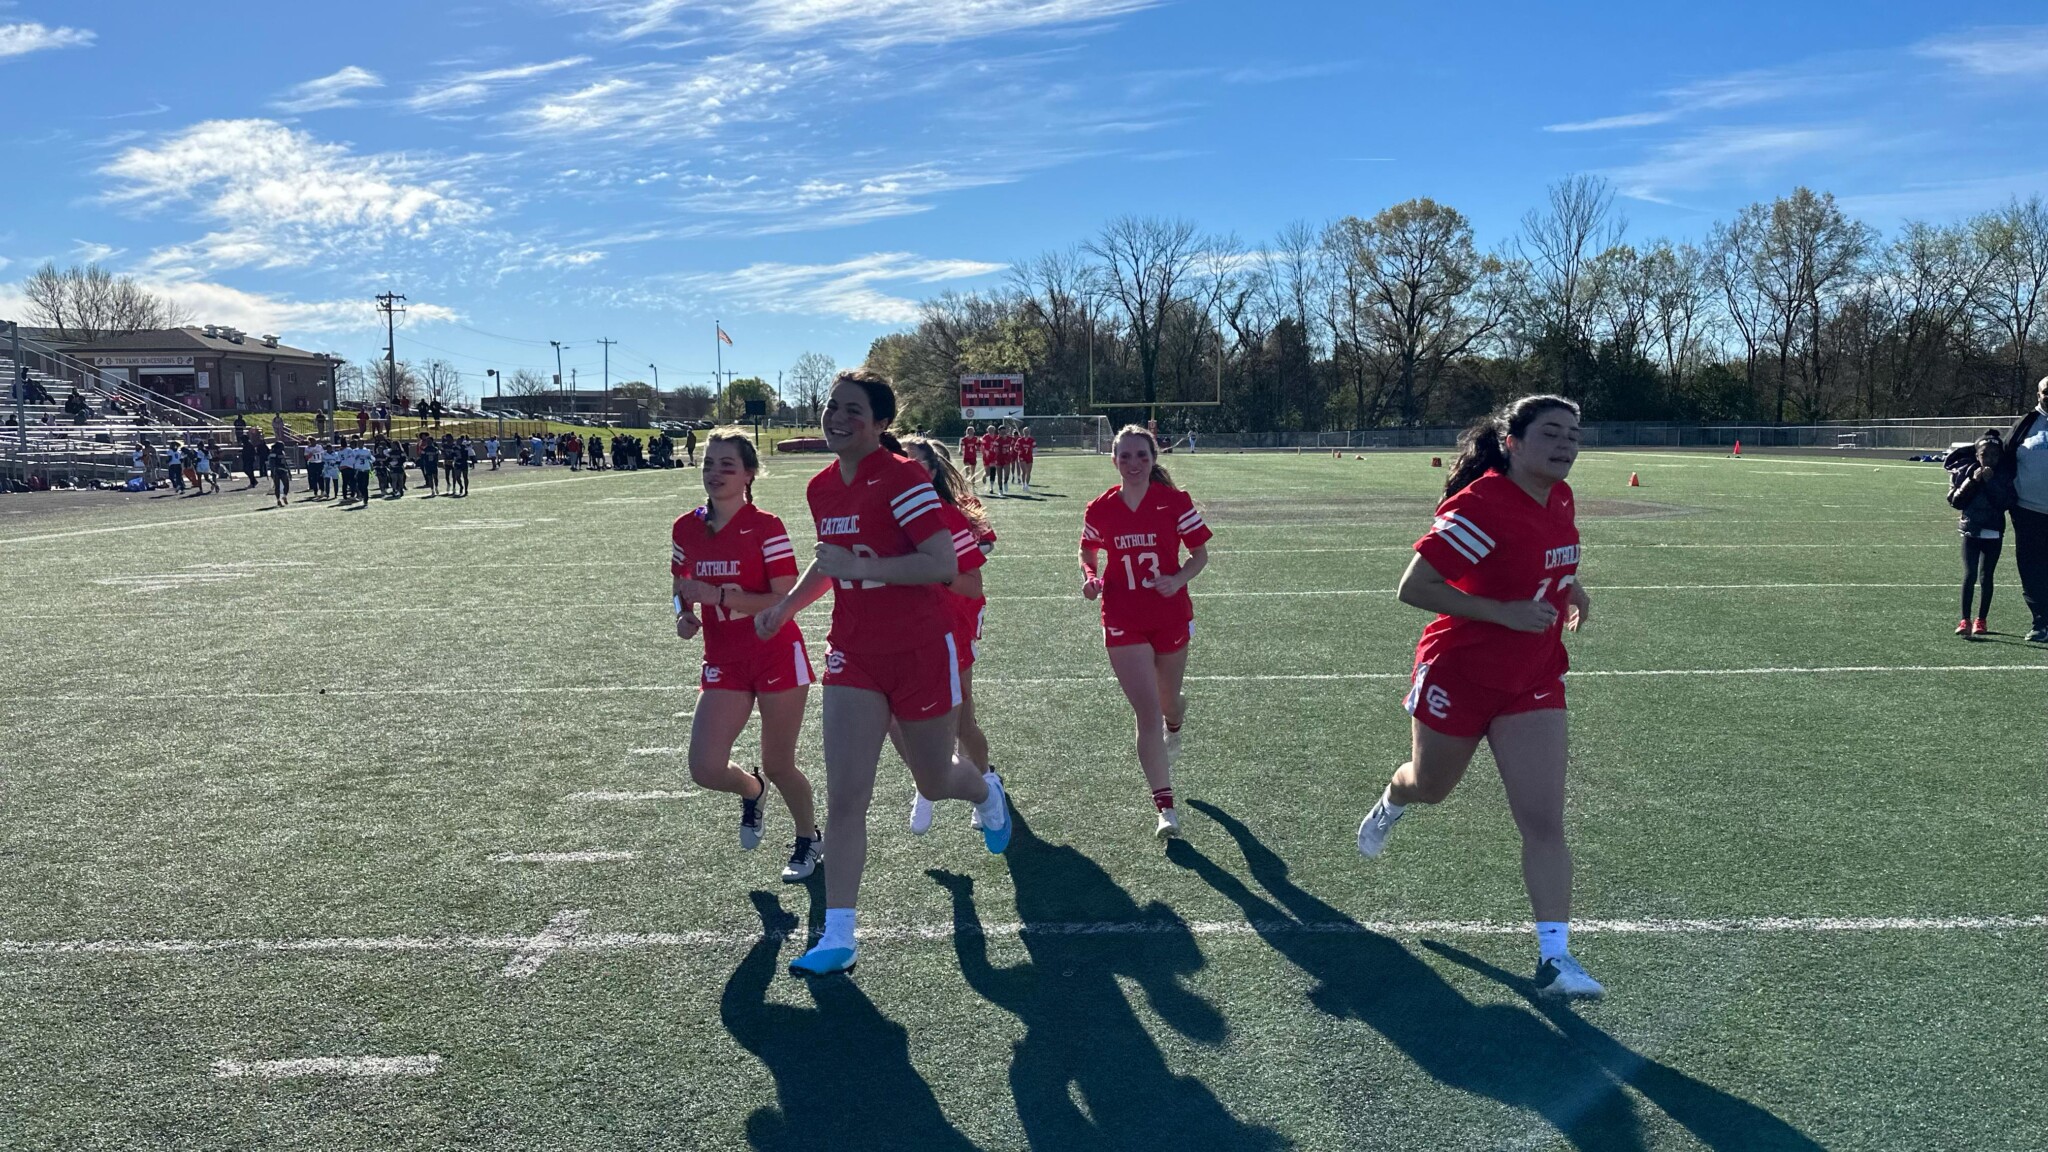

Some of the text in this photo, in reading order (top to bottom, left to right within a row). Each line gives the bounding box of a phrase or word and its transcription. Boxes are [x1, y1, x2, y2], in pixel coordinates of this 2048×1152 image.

[115, 357, 140, 365] TROJANS
[820, 515, 860, 536] CATHOLIC
[1113, 533, 1157, 550] CATHOLIC
[1544, 544, 1581, 570] CATHOLI
[696, 560, 741, 577] CATHOLIC
[1120, 552, 1161, 591] 13
